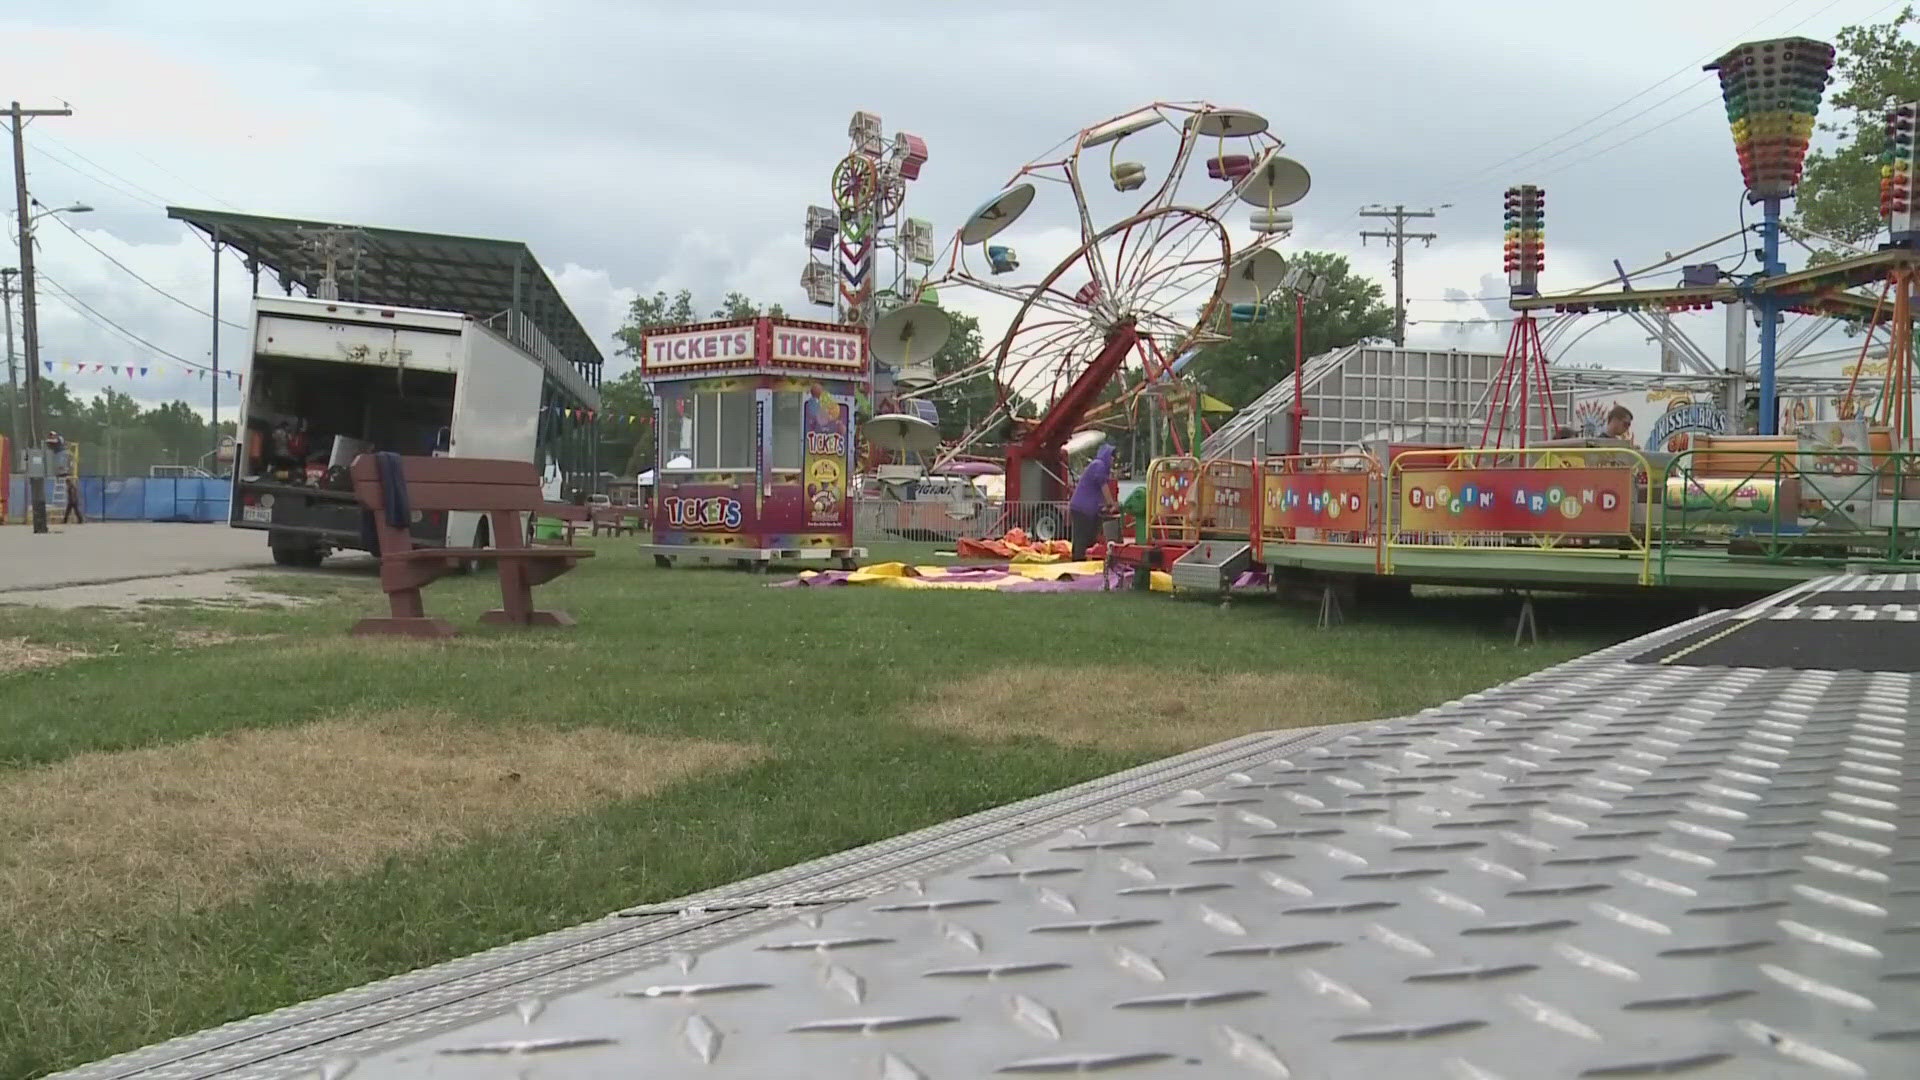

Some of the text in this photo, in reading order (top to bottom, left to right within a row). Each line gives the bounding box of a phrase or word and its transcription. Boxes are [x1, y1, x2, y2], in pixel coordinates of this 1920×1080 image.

[654, 333, 747, 362] TICKETS
[778, 333, 857, 361] TICKETS
[807, 431, 844, 456] TICKETS
[665, 496, 741, 528] TICKETS
[1214, 488, 1241, 507] ENTER
[1307, 489, 1361, 518] AROUND
[1410, 483, 1618, 518] BUGGIN' AROUND
